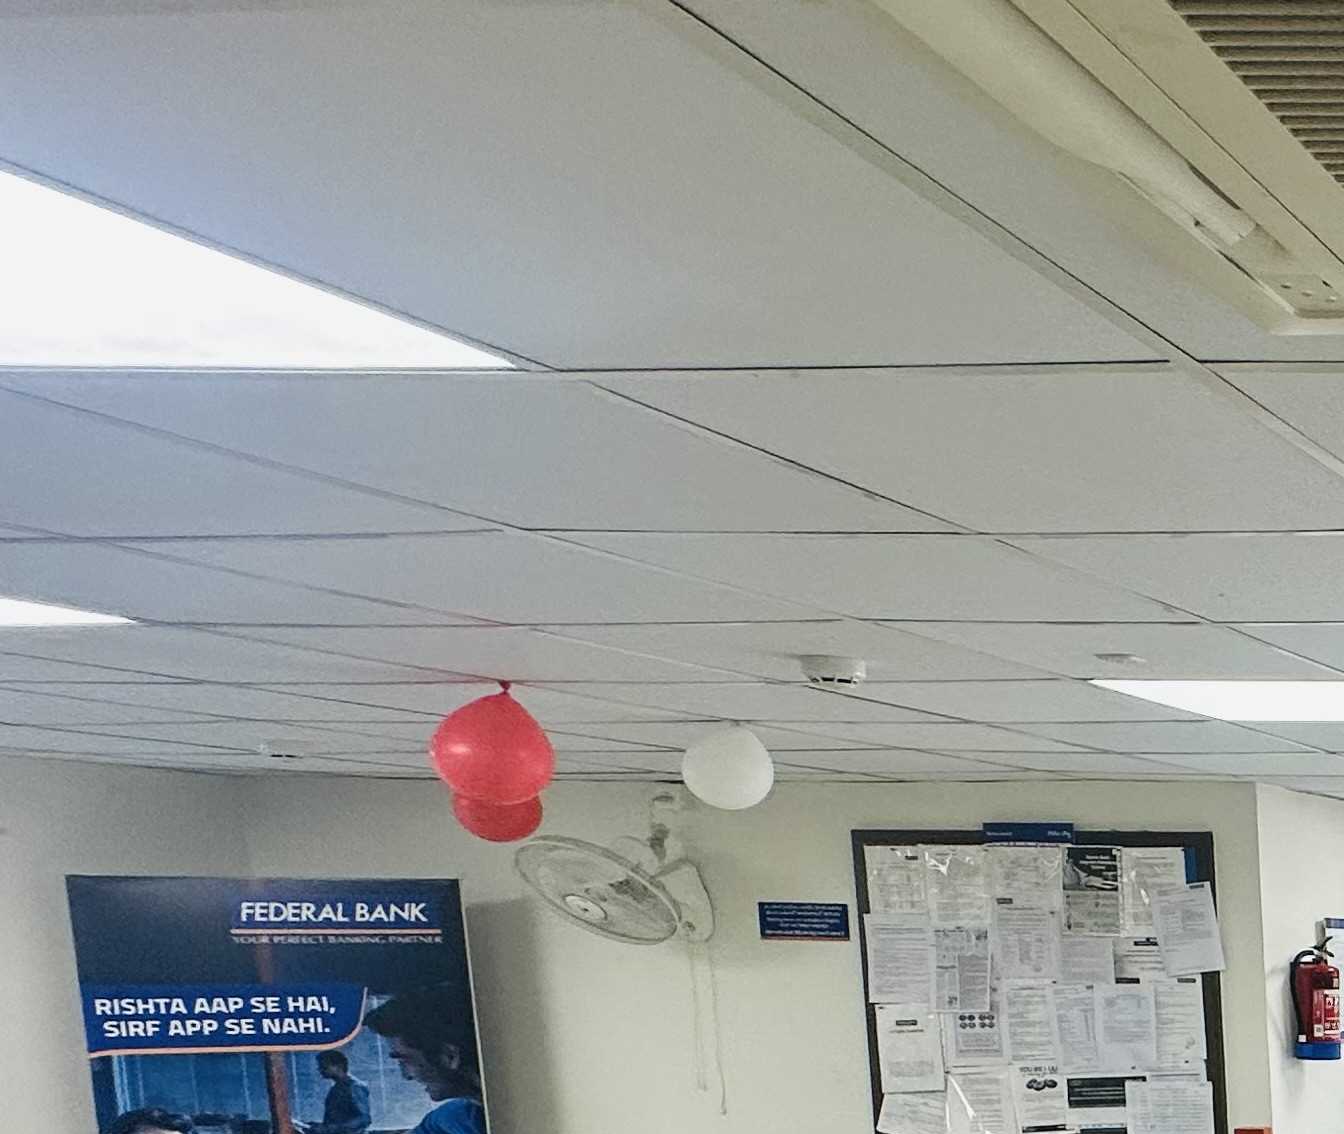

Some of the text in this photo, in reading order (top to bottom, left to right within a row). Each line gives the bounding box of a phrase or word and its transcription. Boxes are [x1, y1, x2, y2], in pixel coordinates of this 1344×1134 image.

[240, 902, 428, 922] FEDERAL BANK
[231, 935, 269, 945] YOUR
[273, 935, 324, 945] PERFECT
[389, 935, 444, 945] PARTNER
[95, 996, 336, 1015] RISHTA AAP SE HAI,
[103, 1017, 331, 1037] SIRF APP SE NAHI.
